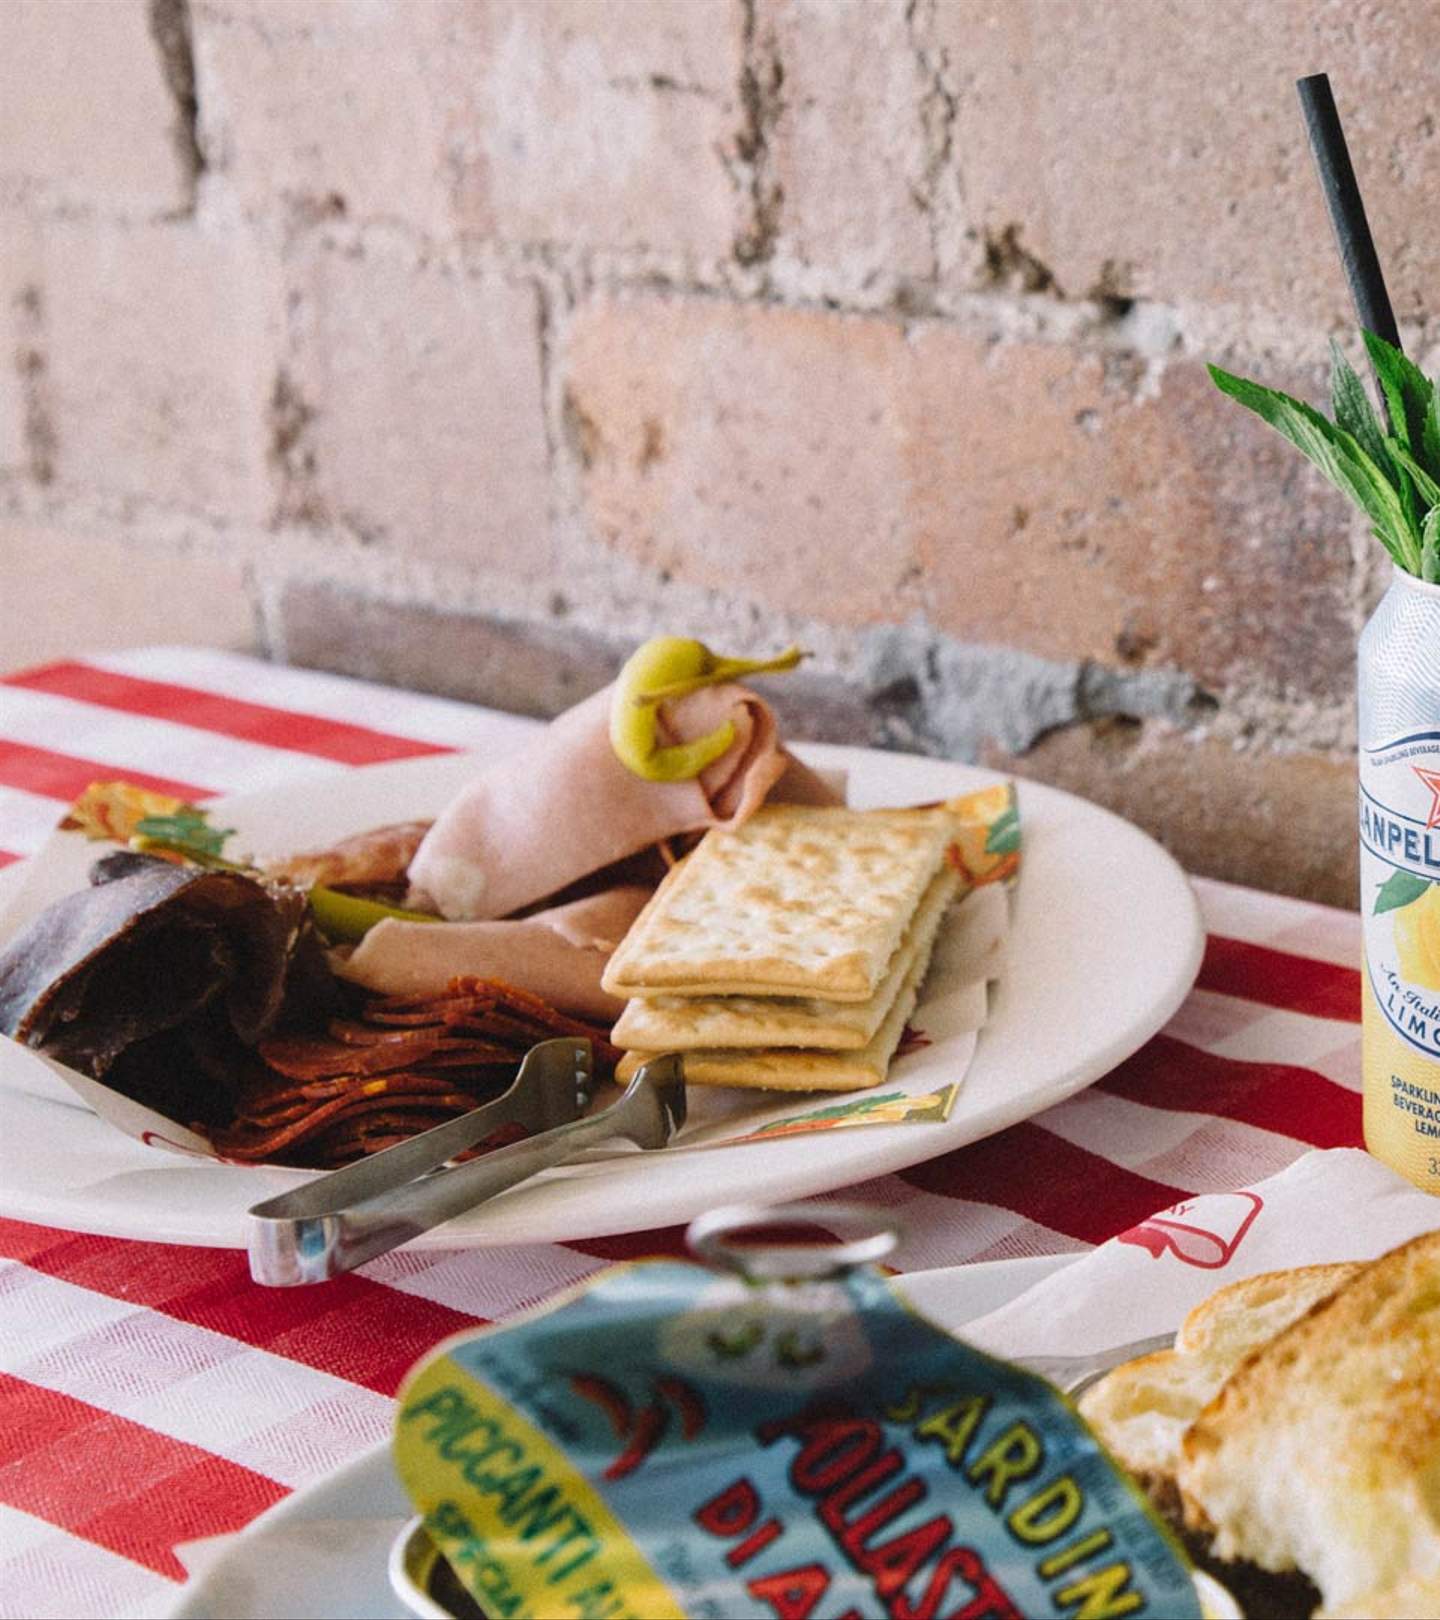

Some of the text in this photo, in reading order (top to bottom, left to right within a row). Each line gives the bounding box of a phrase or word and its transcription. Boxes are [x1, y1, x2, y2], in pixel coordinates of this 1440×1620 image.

[1380, 963, 1401, 992] An
[401, 1383, 603, 1584] PICCANTI
[693, 1476, 786, 1569] DI
